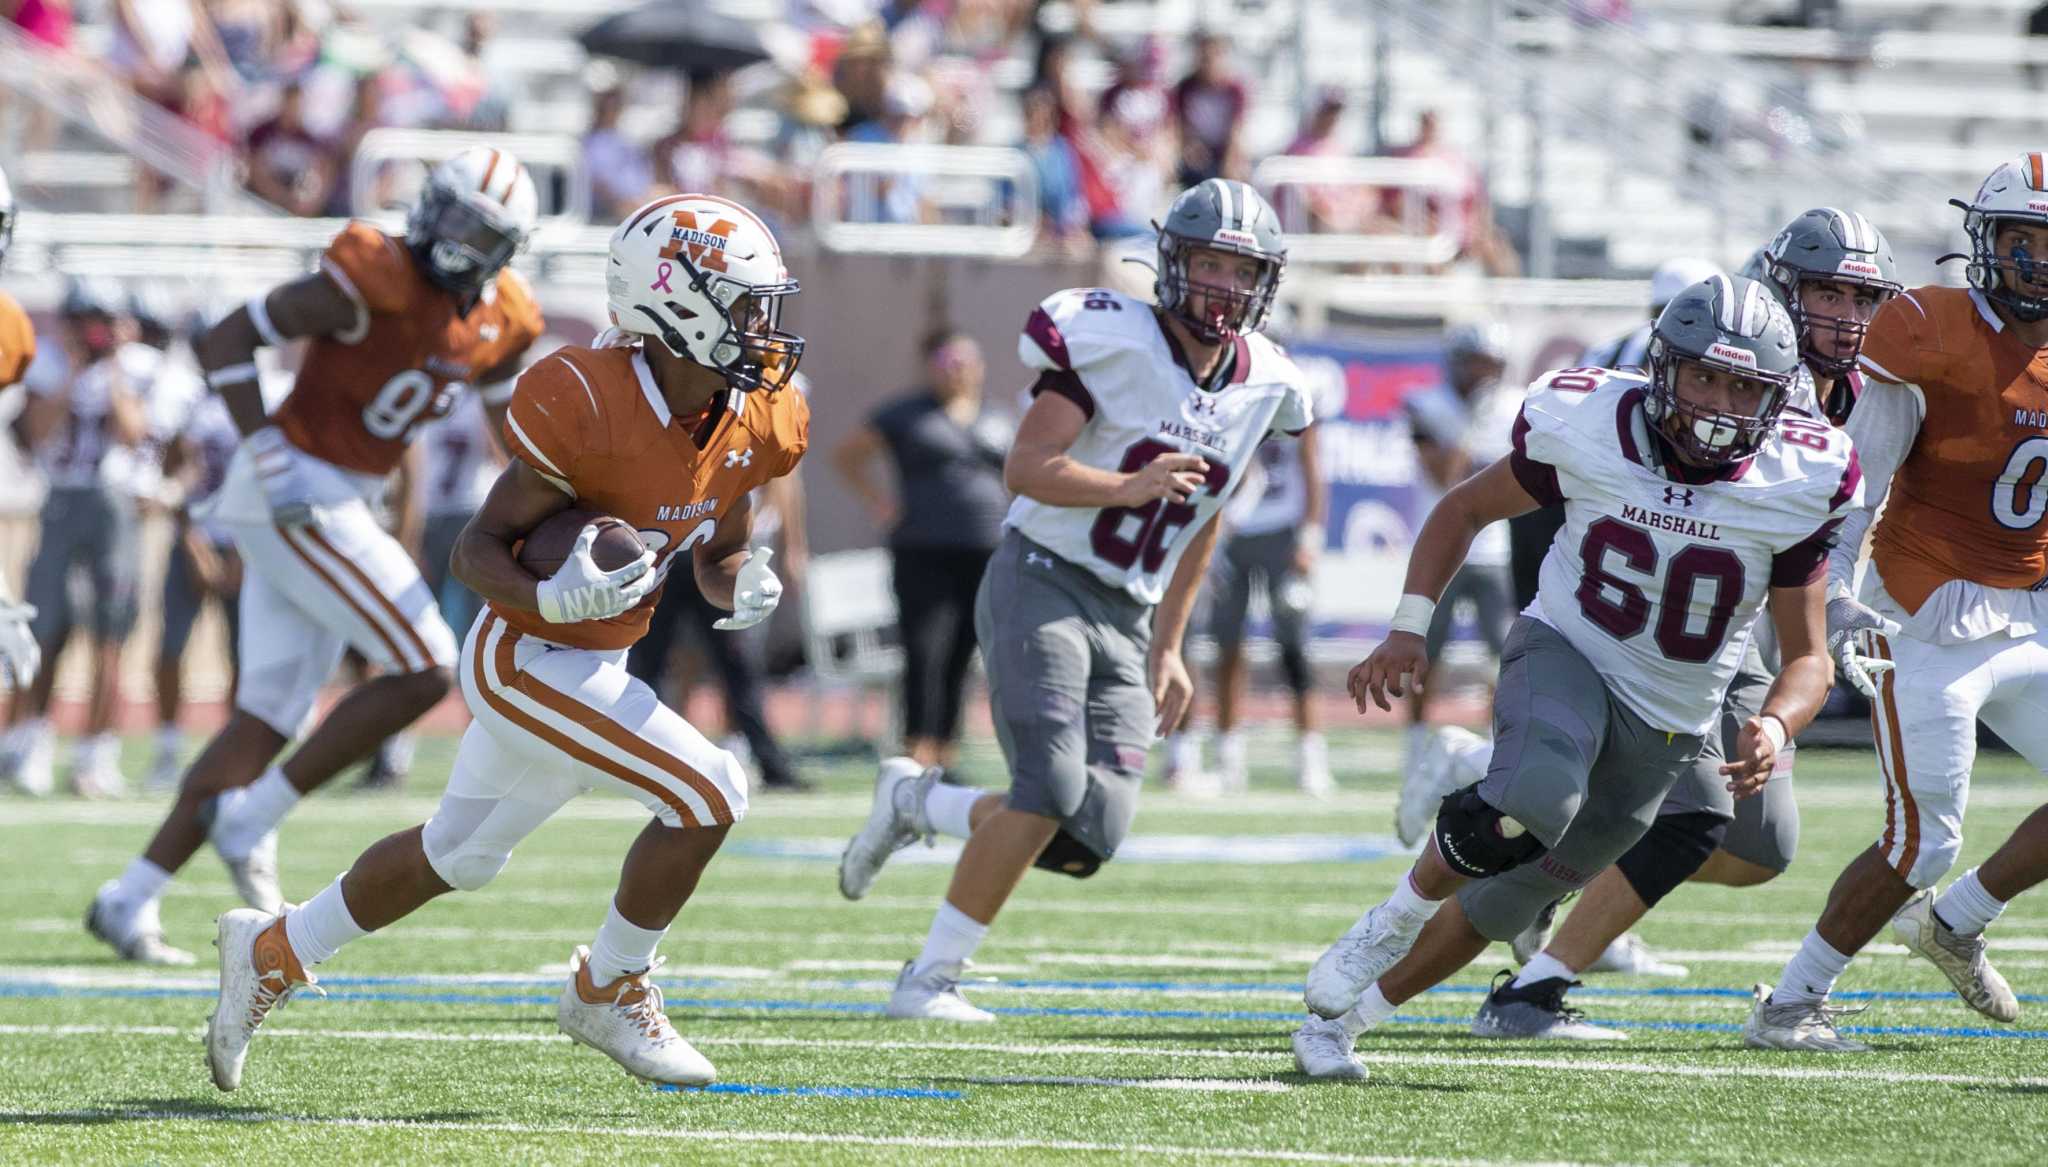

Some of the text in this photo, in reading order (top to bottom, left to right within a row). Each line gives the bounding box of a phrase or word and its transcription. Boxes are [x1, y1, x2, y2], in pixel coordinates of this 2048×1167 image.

[671, 227, 727, 250] MADISON
[1844, 264, 1878, 274] Riddell
[1713, 346, 1752, 363] Riddell
[2014, 408, 2047, 428] MAD
[655, 496, 719, 521] MADISON
[1621, 503, 1720, 541] MARSHALL
[1575, 515, 1746, 664] 60
